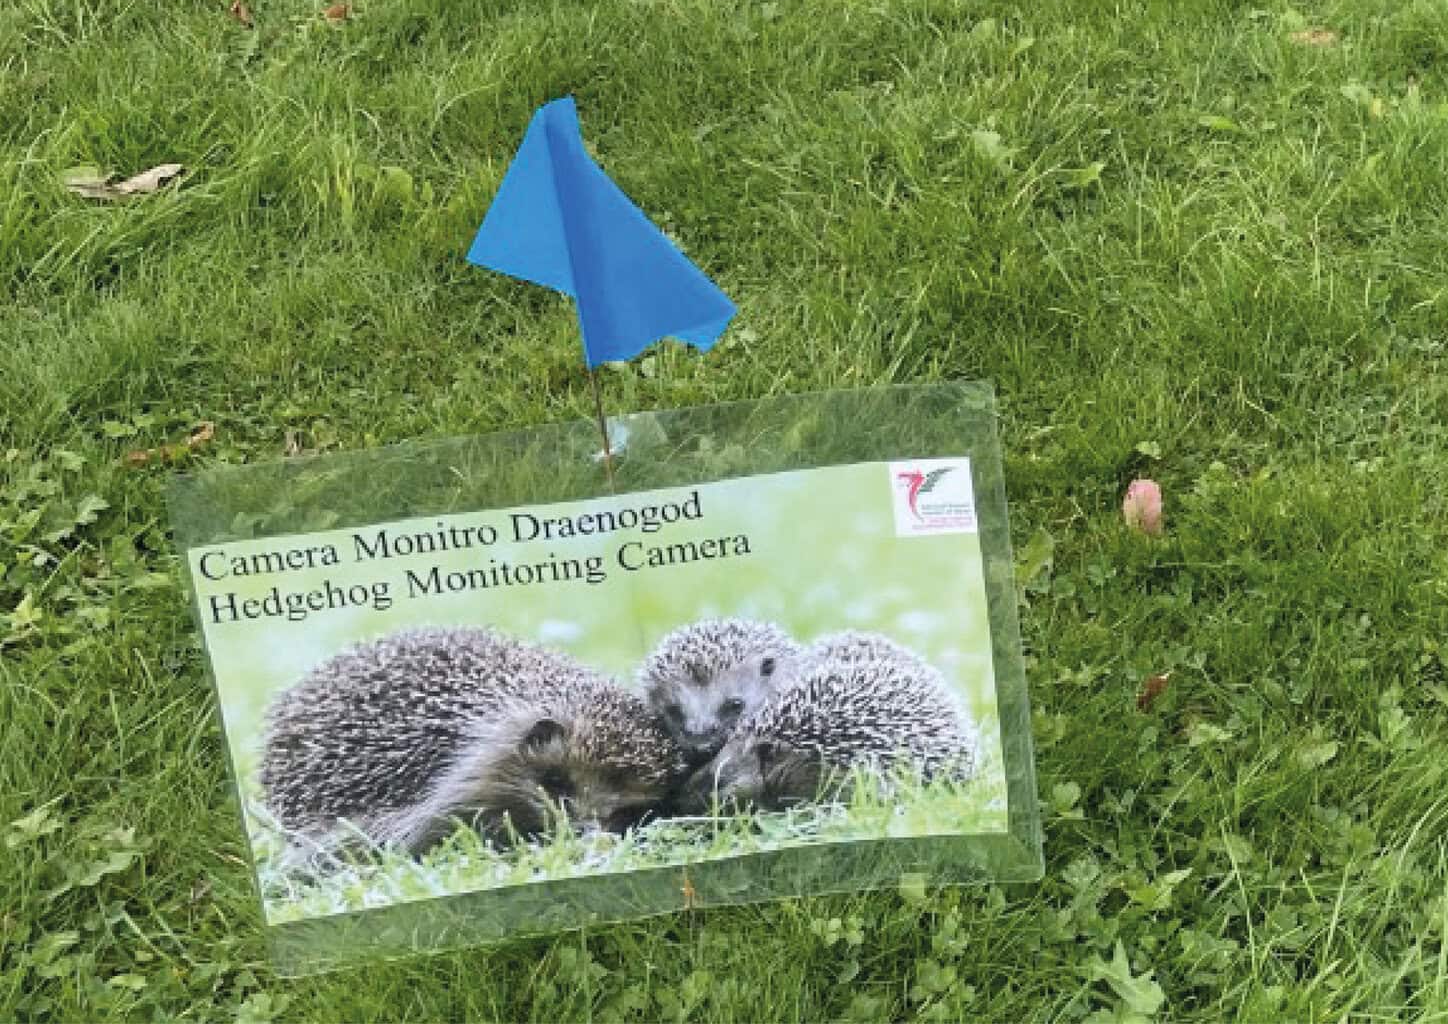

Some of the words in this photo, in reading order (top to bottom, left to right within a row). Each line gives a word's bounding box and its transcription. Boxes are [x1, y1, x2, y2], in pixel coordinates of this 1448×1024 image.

[199, 543, 341, 581] Camera
[351, 521, 497, 562] Monitro
[508, 491, 704, 543] Draenogod
[208, 579, 393, 624] Hedgehog
[404, 552, 607, 599] Monitoring
[616, 533, 752, 572] Camera
